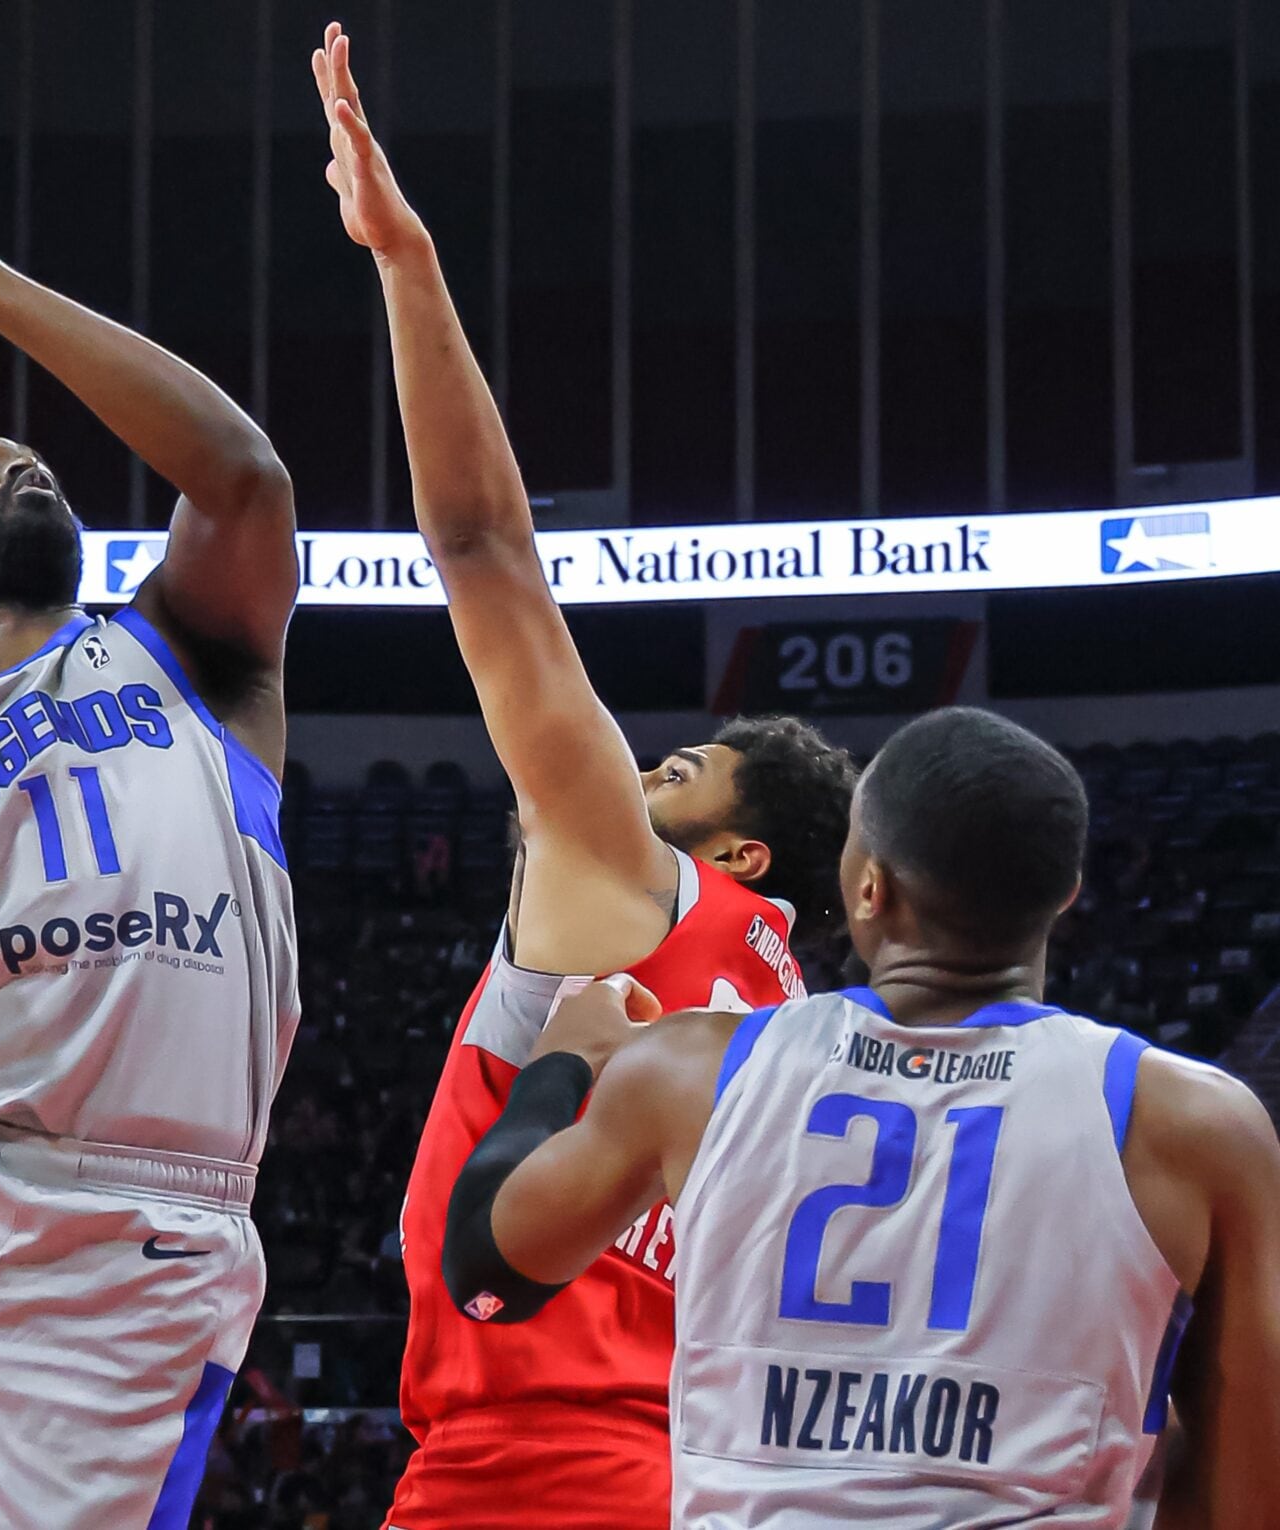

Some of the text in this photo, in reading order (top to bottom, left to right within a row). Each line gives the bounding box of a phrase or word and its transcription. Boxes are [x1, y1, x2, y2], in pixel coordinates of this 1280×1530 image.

[300, 539, 435, 589] Lone
[595, 531, 822, 585] National
[848, 523, 991, 577] Bank
[777, 632, 913, 690] 206
[18, 766, 121, 884] 11
[754, 923, 785, 972] NBA
[847, 1032, 896, 1077] NBA
[934, 1050, 1016, 1084] LEAGUE
[778, 1093, 1005, 1331] 21
[761, 1364, 1000, 1465] NZEAKOR
